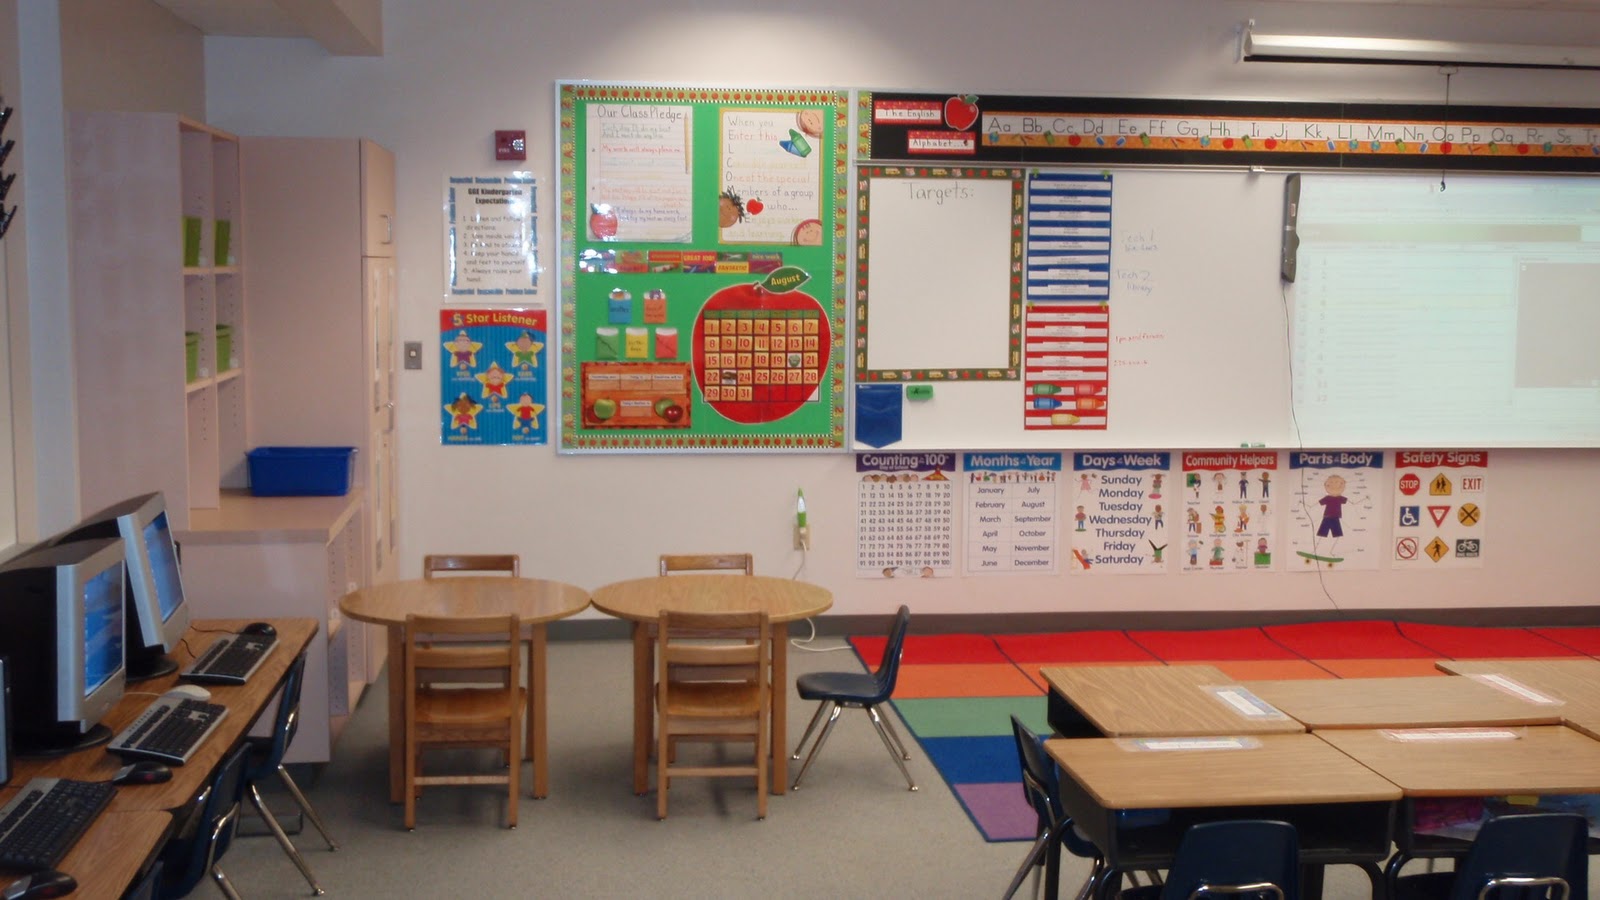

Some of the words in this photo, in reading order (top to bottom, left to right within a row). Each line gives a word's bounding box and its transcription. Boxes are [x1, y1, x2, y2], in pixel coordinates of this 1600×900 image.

[597, 105, 617, 118] Our
[621, 105, 648, 119] Class
[650, 105, 682, 123] Pledge
[885, 108, 903, 117] The
[907, 109, 935, 121] English
[728, 115, 754, 127] When
[759, 119, 774, 128] you
[728, 129, 753, 141] Enter
[759, 130, 778, 142] this
[988, 117, 1011, 132] Aa
[1022, 117, 1043, 133] Bb
[1052, 118, 1074, 134] Cc
[1083, 118, 1104, 134] Dd
[1118, 119, 1137, 134] Ee
[1149, 119, 1167, 135] Ff
[1177, 120, 1199, 141] Gg
[1209, 121, 1231, 136] Hh
[1251, 122, 1260, 137] Ii
[1275, 122, 1288, 144] Jj
[1304, 123, 1322, 138] Kk
[1338, 124, 1352, 139] Ll
[1367, 125, 1395, 140] Mm
[1403, 126, 1424, 140] Nn
[1432, 126, 1454, 142] Oo
[1461, 127, 1480, 145] Pp
[1491, 127, 1516, 146] Qq
[1527, 127, 1544, 144] Rr
[1556, 128, 1572, 144] Ss
[776, 172, 810, 186] special
[481, 188, 522, 196] Kindergarten
[772, 186, 782, 197] of
[791, 190, 814, 200] group
[902, 181, 974, 205] Targets:
[770, 273, 800, 286] August
[453, 313, 463, 327] 5
[466, 313, 489, 323] Star
[493, 312, 538, 326] Listener
[710, 323, 714, 332] 1
[726, 323, 731, 331] 2
[742, 323, 748, 332] 3
[776, 324, 781, 332] 5
[792, 324, 798, 332] 6
[808, 323, 813, 332] 7
[709, 339, 716, 348] 8
[726, 339, 732, 348] 9
[740, 339, 749, 347] 10
[759, 340, 764, 348] 11
[774, 340, 782, 348] 12
[791, 340, 799, 348] 13
[806, 338, 815, 347] 14
[709, 357, 716, 365] 15
[724, 357, 732, 365] 16
[758, 356, 766, 364] 18
[774, 356, 782, 364] 19
[807, 355, 815, 364] 21
[707, 373, 717, 381] 22
[740, 373, 750, 382] 24
[757, 373, 767, 381] 25
[772, 373, 784, 382] 26
[790, 373, 799, 381] 27
[806, 373, 816, 381] 28
[707, 389, 717, 397] 29
[723, 389, 734, 397] 30
[741, 389, 749, 397] 31
[862, 454, 918, 469] Counting
[970, 454, 1019, 467] Months
[1026, 455, 1055, 467] Year
[1082, 454, 1116, 469] Days
[1123, 454, 1161, 467] Week
[1186, 455, 1237, 468] Community
[1240, 454, 1274, 467] Helpers
[1300, 453, 1333, 465] Parts
[1341, 452, 1373, 466] Body
[1402, 451, 1443, 466] Safety
[1447, 451, 1481, 465] Signs
[1101, 475, 1142, 486] Sunday
[1400, 480, 1419, 489] STOP
[1463, 478, 1482, 490] EXIT
[977, 487, 1004, 495] January
[1026, 486, 1040, 495] July
[1099, 488, 1144, 499] Monday
[975, 501, 1005, 509] February
[1021, 501, 1045, 509] August
[1099, 502, 1143, 513] Tuesday
[980, 515, 1001, 523] March
[1014, 515, 1051, 523] September
[1089, 515, 1151, 526] Wednesday
[982, 530, 998, 538] April
[1096, 528, 1145, 539] Thursday
[982, 545, 997, 553] May
[1014, 544, 1049, 552] November
[1103, 541, 1136, 553] Friday
[981, 559, 998, 567] June
[1095, 555, 1144, 566] Saturday
